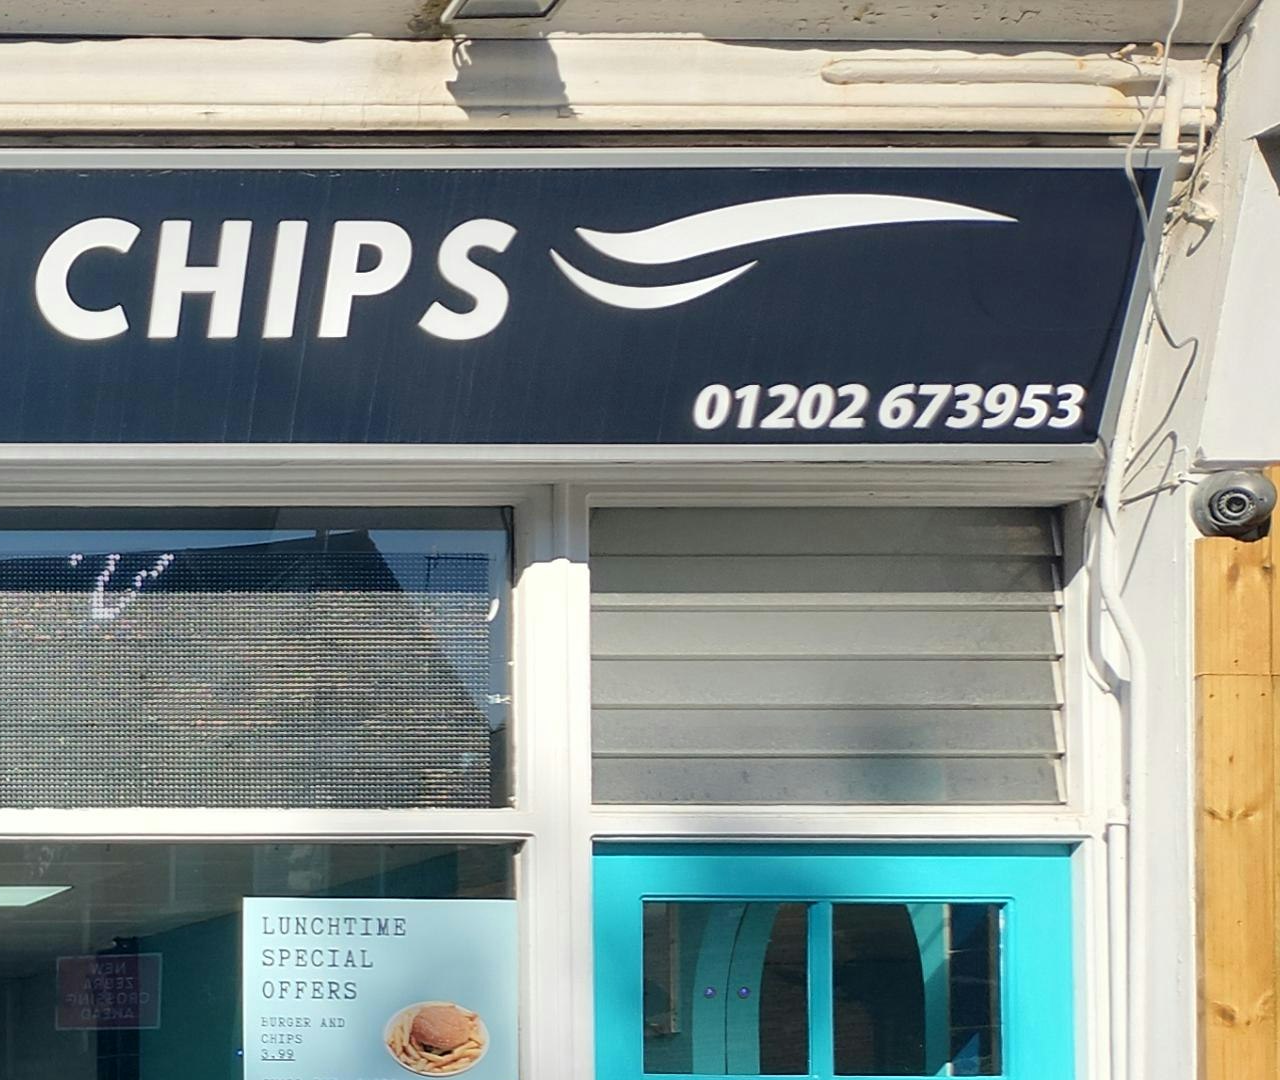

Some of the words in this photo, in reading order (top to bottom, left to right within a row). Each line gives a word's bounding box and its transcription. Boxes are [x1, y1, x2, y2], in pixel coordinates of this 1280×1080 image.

[36, 219, 513, 340] CHIPS
[694, 384, 868, 429] 01202
[878, 384, 1084, 428] 673953
[261, 915, 406, 936] LUNCHTIME
[263, 949, 373, 968] SPECIAL
[263, 981, 357, 999] OFFERS
[261, 1017, 311, 1027] BURGER
[320, 1018, 345, 1027] AND
[261, 1034, 302, 1044] CHIPS
[261, 1049, 296, 1061] 3.99
